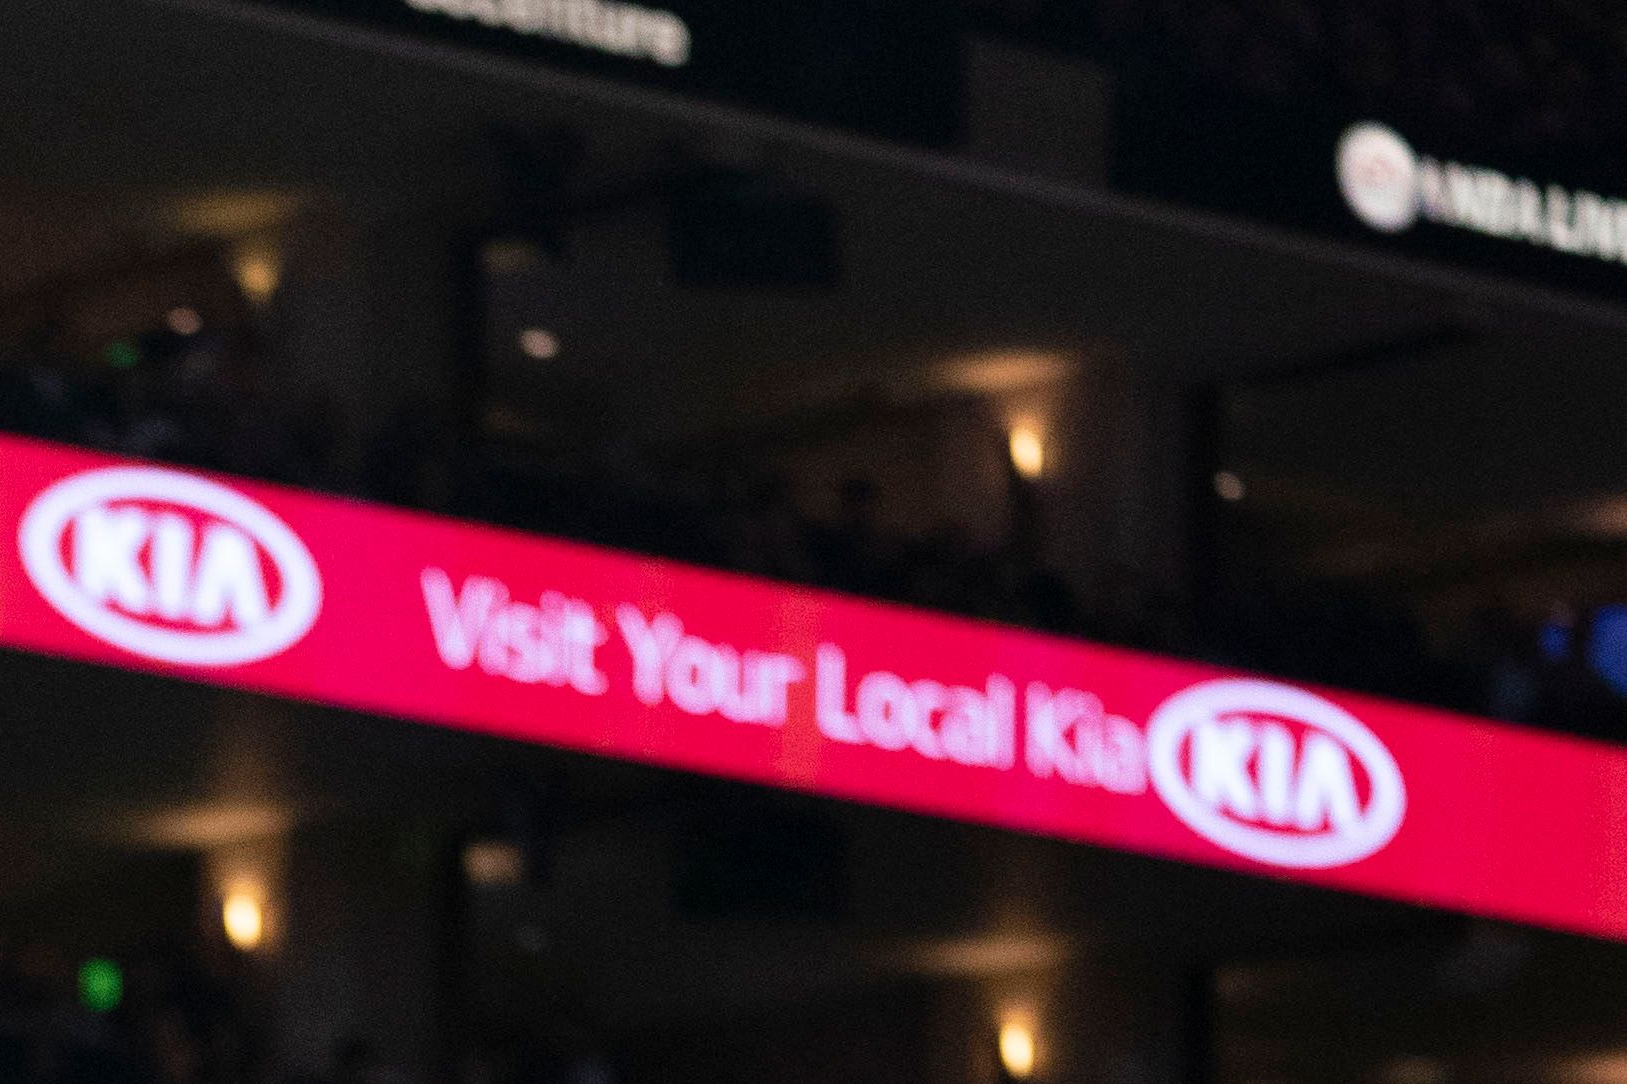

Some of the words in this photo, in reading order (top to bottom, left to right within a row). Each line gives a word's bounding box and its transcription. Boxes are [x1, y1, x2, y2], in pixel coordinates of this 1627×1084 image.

[406, 0, 691, 66] enture
[72, 502, 276, 630] KIA
[421, 566, 608, 696] Visit
[617, 600, 805, 728] Your
[815, 641, 1016, 770] Local
[1024, 680, 1147, 795] Kia
[1188, 717, 1360, 834] KIA
